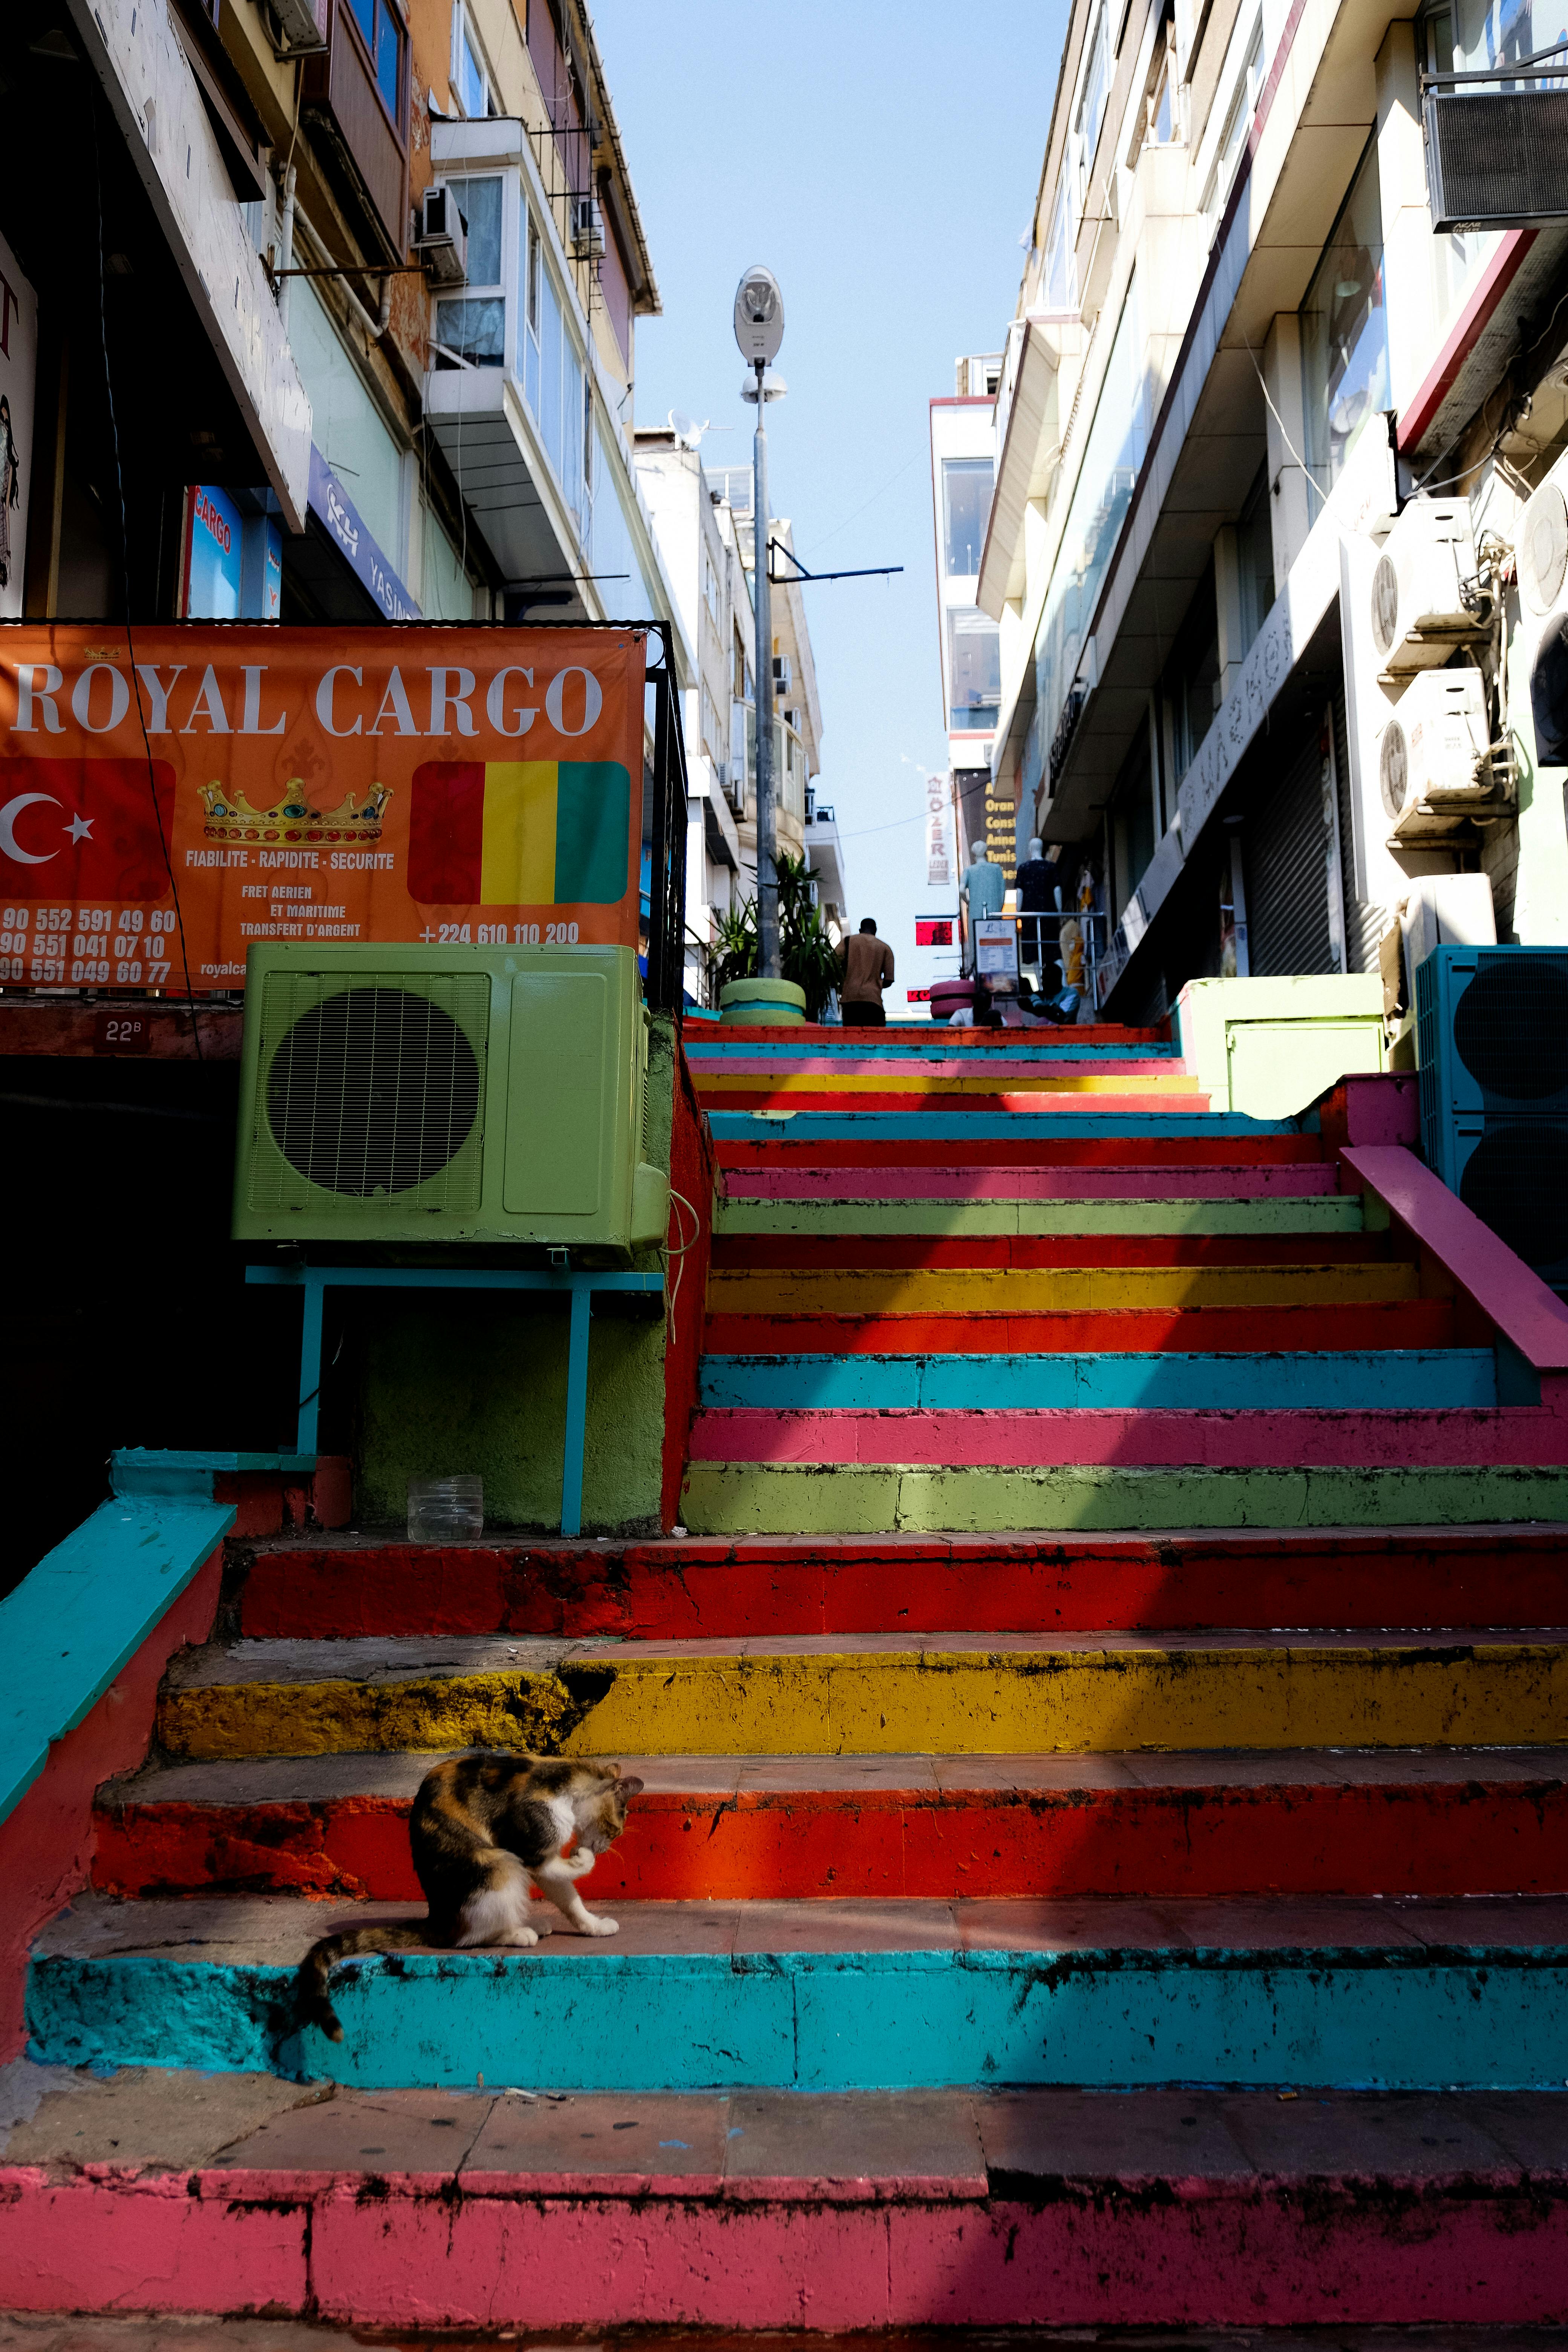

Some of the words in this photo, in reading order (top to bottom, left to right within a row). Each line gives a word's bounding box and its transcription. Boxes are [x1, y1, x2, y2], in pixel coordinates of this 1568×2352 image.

[194, 485, 231, 556] CARGO
[10, 663, 286, 735] ROYAL
[316, 665, 603, 737] CARGO
[985, 799, 1014, 812] Oran
[186, 850, 248, 867] FIABILITE
[259, 851, 319, 869] RAPIDITE
[330, 852, 394, 870] SECURITE
[986, 849, 1016, 863] Tunis
[242, 885, 268, 898] FRET
[272, 886, 312, 899] AERIEN
[2, 908, 29, 930] 90
[36, 908, 72, 931] 552
[78, 909, 112, 932] 591
[118, 910, 143, 932] 49
[151, 910, 176, 933] 60
[270, 905, 283, 917] ET
[287, 905, 346, 918] MARITIME
[240, 923, 303, 936] TRANSFERT
[307, 923, 360, 937] D'ARGENT
[478, 923, 507, 944] 610
[513, 923, 540, 945] 110
[545, 922, 579, 944] 200
[0, 932, 26, 954] 90
[33, 933, 66, 957] 551
[74, 934, 107, 958] 041
[114, 935, 140, 958] 07
[143, 936, 164, 959] 10
[0, 957, 23, 980] 90
[31, 959, 64, 982] 551
[72, 960, 110, 983] 049
[117, 961, 142, 983] 60
[147, 962, 171, 983] 77
